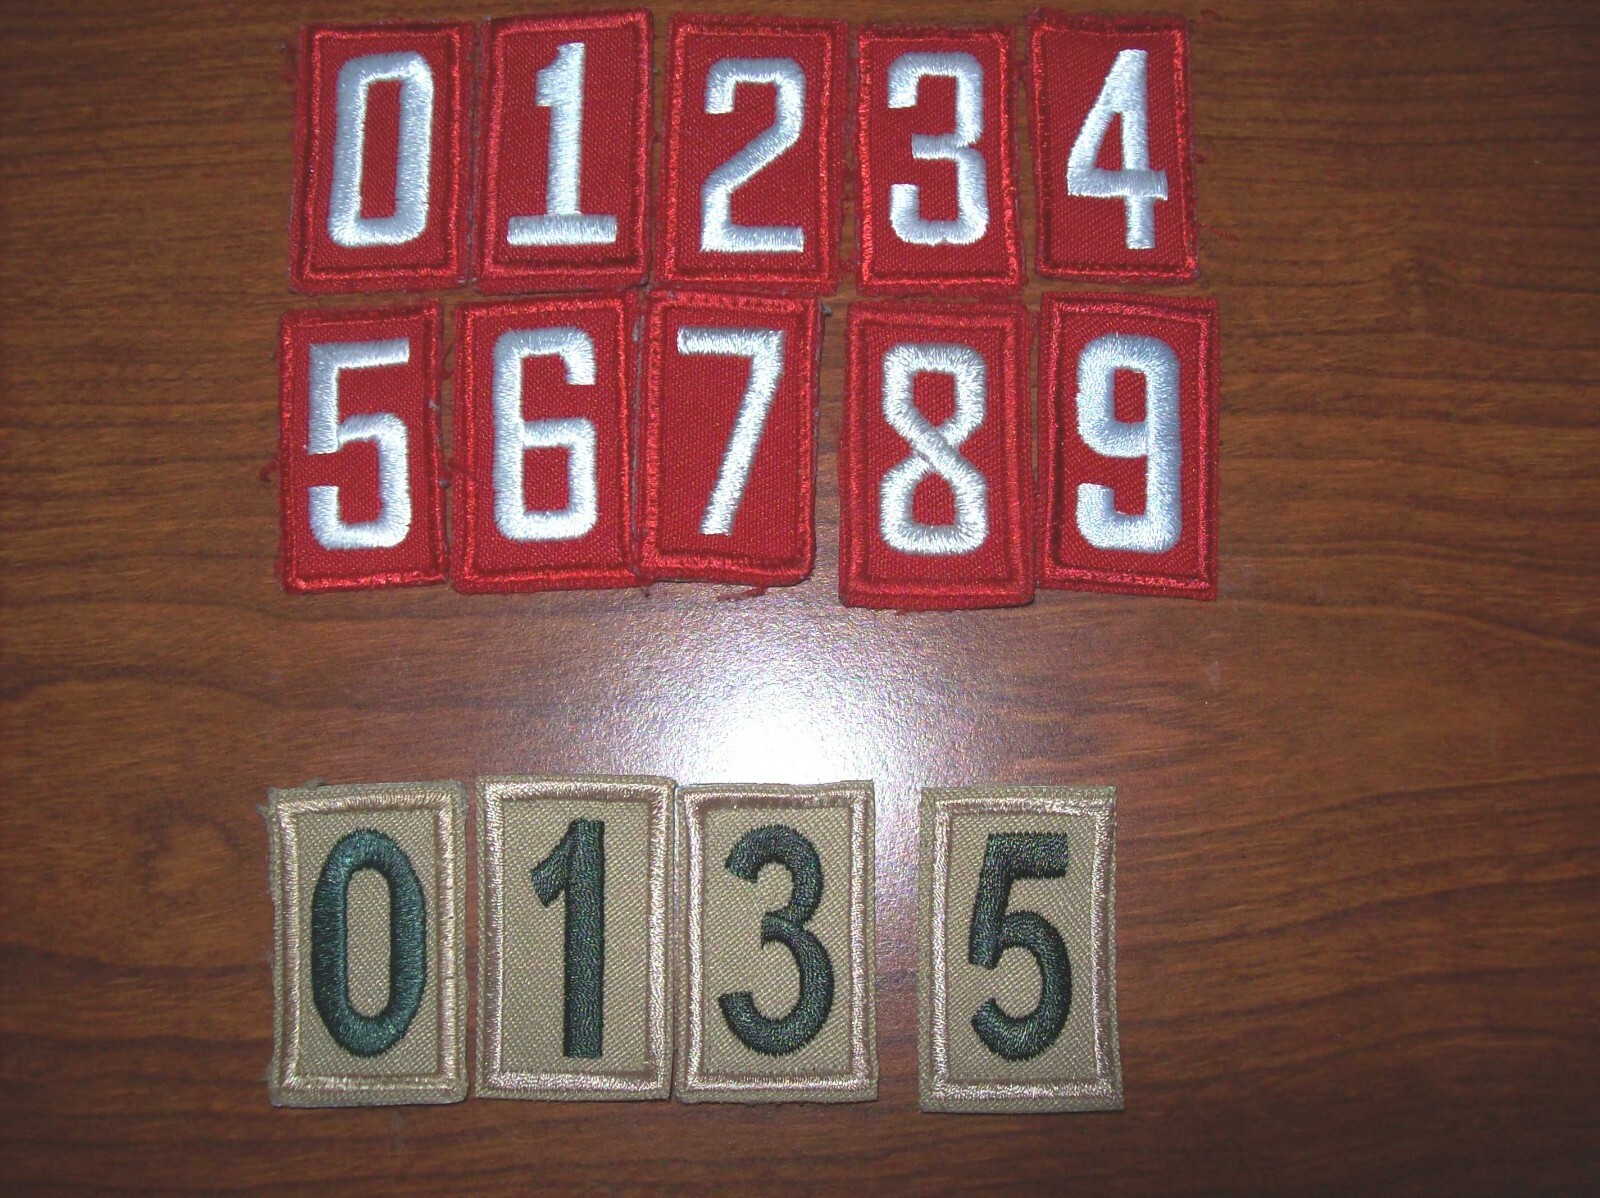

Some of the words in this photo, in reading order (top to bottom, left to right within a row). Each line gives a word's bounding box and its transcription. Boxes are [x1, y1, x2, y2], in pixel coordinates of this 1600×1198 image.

[329, 51, 435, 248] 0
[507, 42, 618, 247] 1
[700, 58, 806, 253] 2
[888, 53, 989, 247] 3
[1066, 49, 1168, 250] 4
[308, 338, 413, 550] 5
[493, 328, 598, 541] 6
[677, 328, 783, 535] 7
[880, 345, 988, 555] 8
[1075, 335, 1182, 553] 9
[311, 829, 425, 1057] 0
[530, 819, 605, 1058] 1
[718, 825, 835, 1056] 3
[969, 832, 1072, 1062] 5
